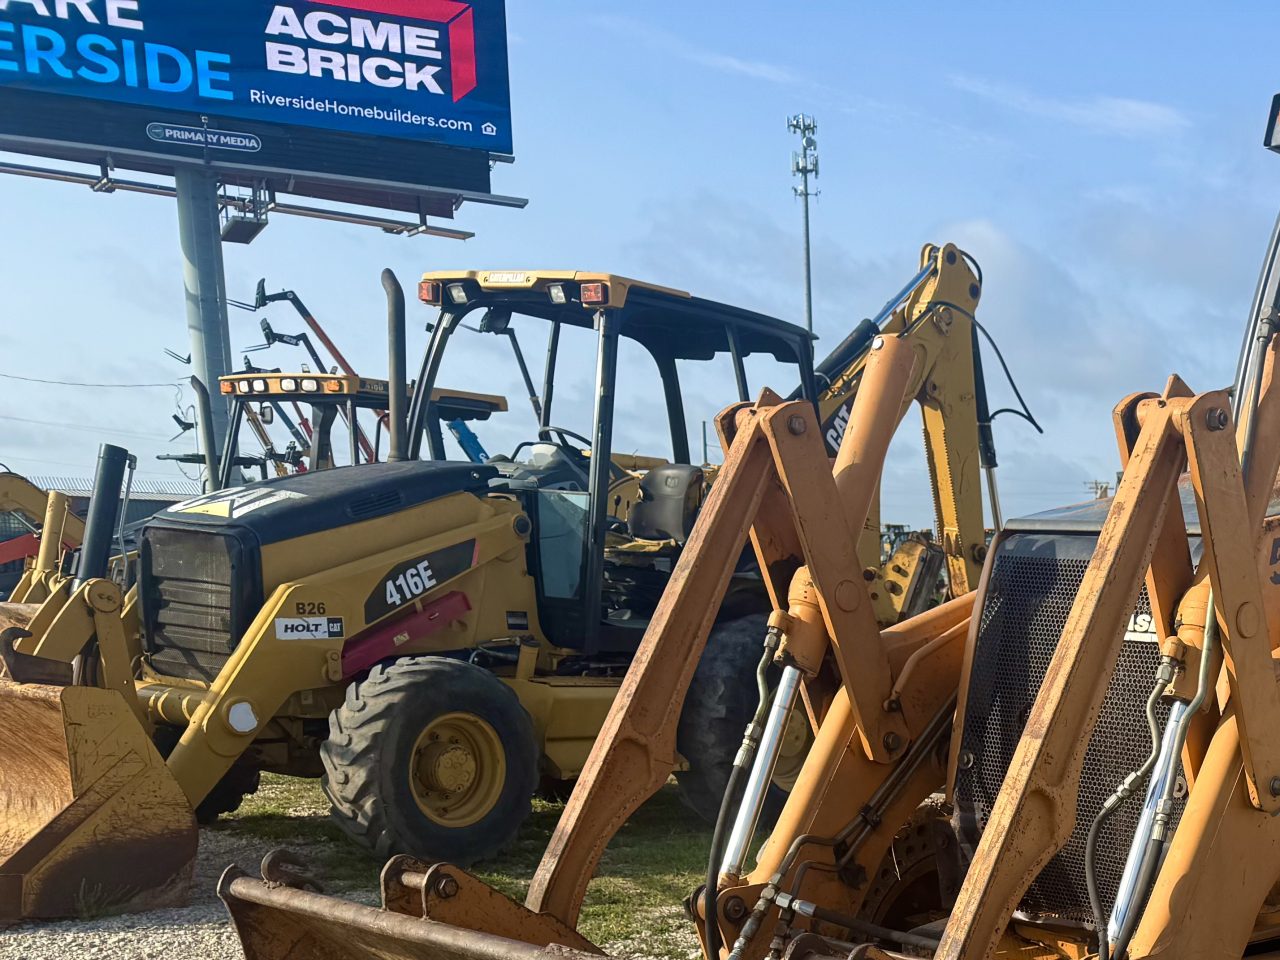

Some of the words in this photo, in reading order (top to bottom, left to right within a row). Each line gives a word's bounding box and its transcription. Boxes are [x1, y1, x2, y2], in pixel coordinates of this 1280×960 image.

[264, 5, 443, 59] ACME
[265, 41, 446, 96] BRICK
[249, 89, 473, 132] RiversideHomebuilders.com
[164, 128, 219, 143] PRIMARY
[220, 135, 258, 148] MEDIA
[826, 403, 851, 452] CAT
[385, 559, 437, 607] 416E
[283, 623, 322, 633] HOLT
[328, 622, 342, 632] CAT
[295, 602, 327, 615] B26
